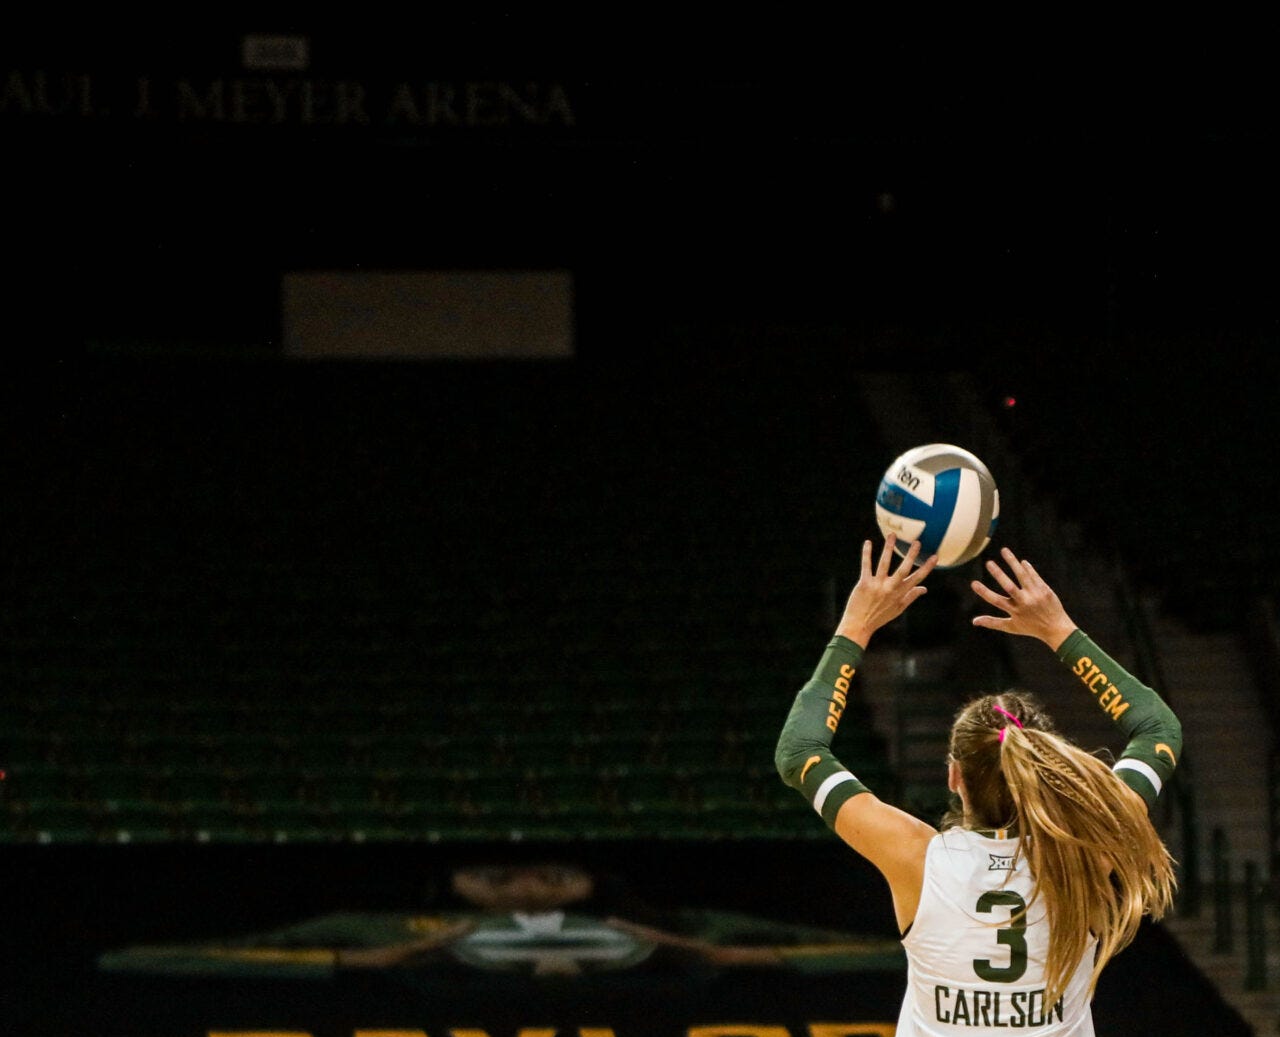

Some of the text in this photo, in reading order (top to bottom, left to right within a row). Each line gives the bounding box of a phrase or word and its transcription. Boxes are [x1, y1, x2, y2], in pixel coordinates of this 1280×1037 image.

[174, 77, 370, 125] MEYER
[386, 78, 577, 127] ARENA
[1072, 656, 1130, 721] SIC'EM
[973, 890, 1028, 983] 3
[935, 985, 1064, 1027] CARLSON
